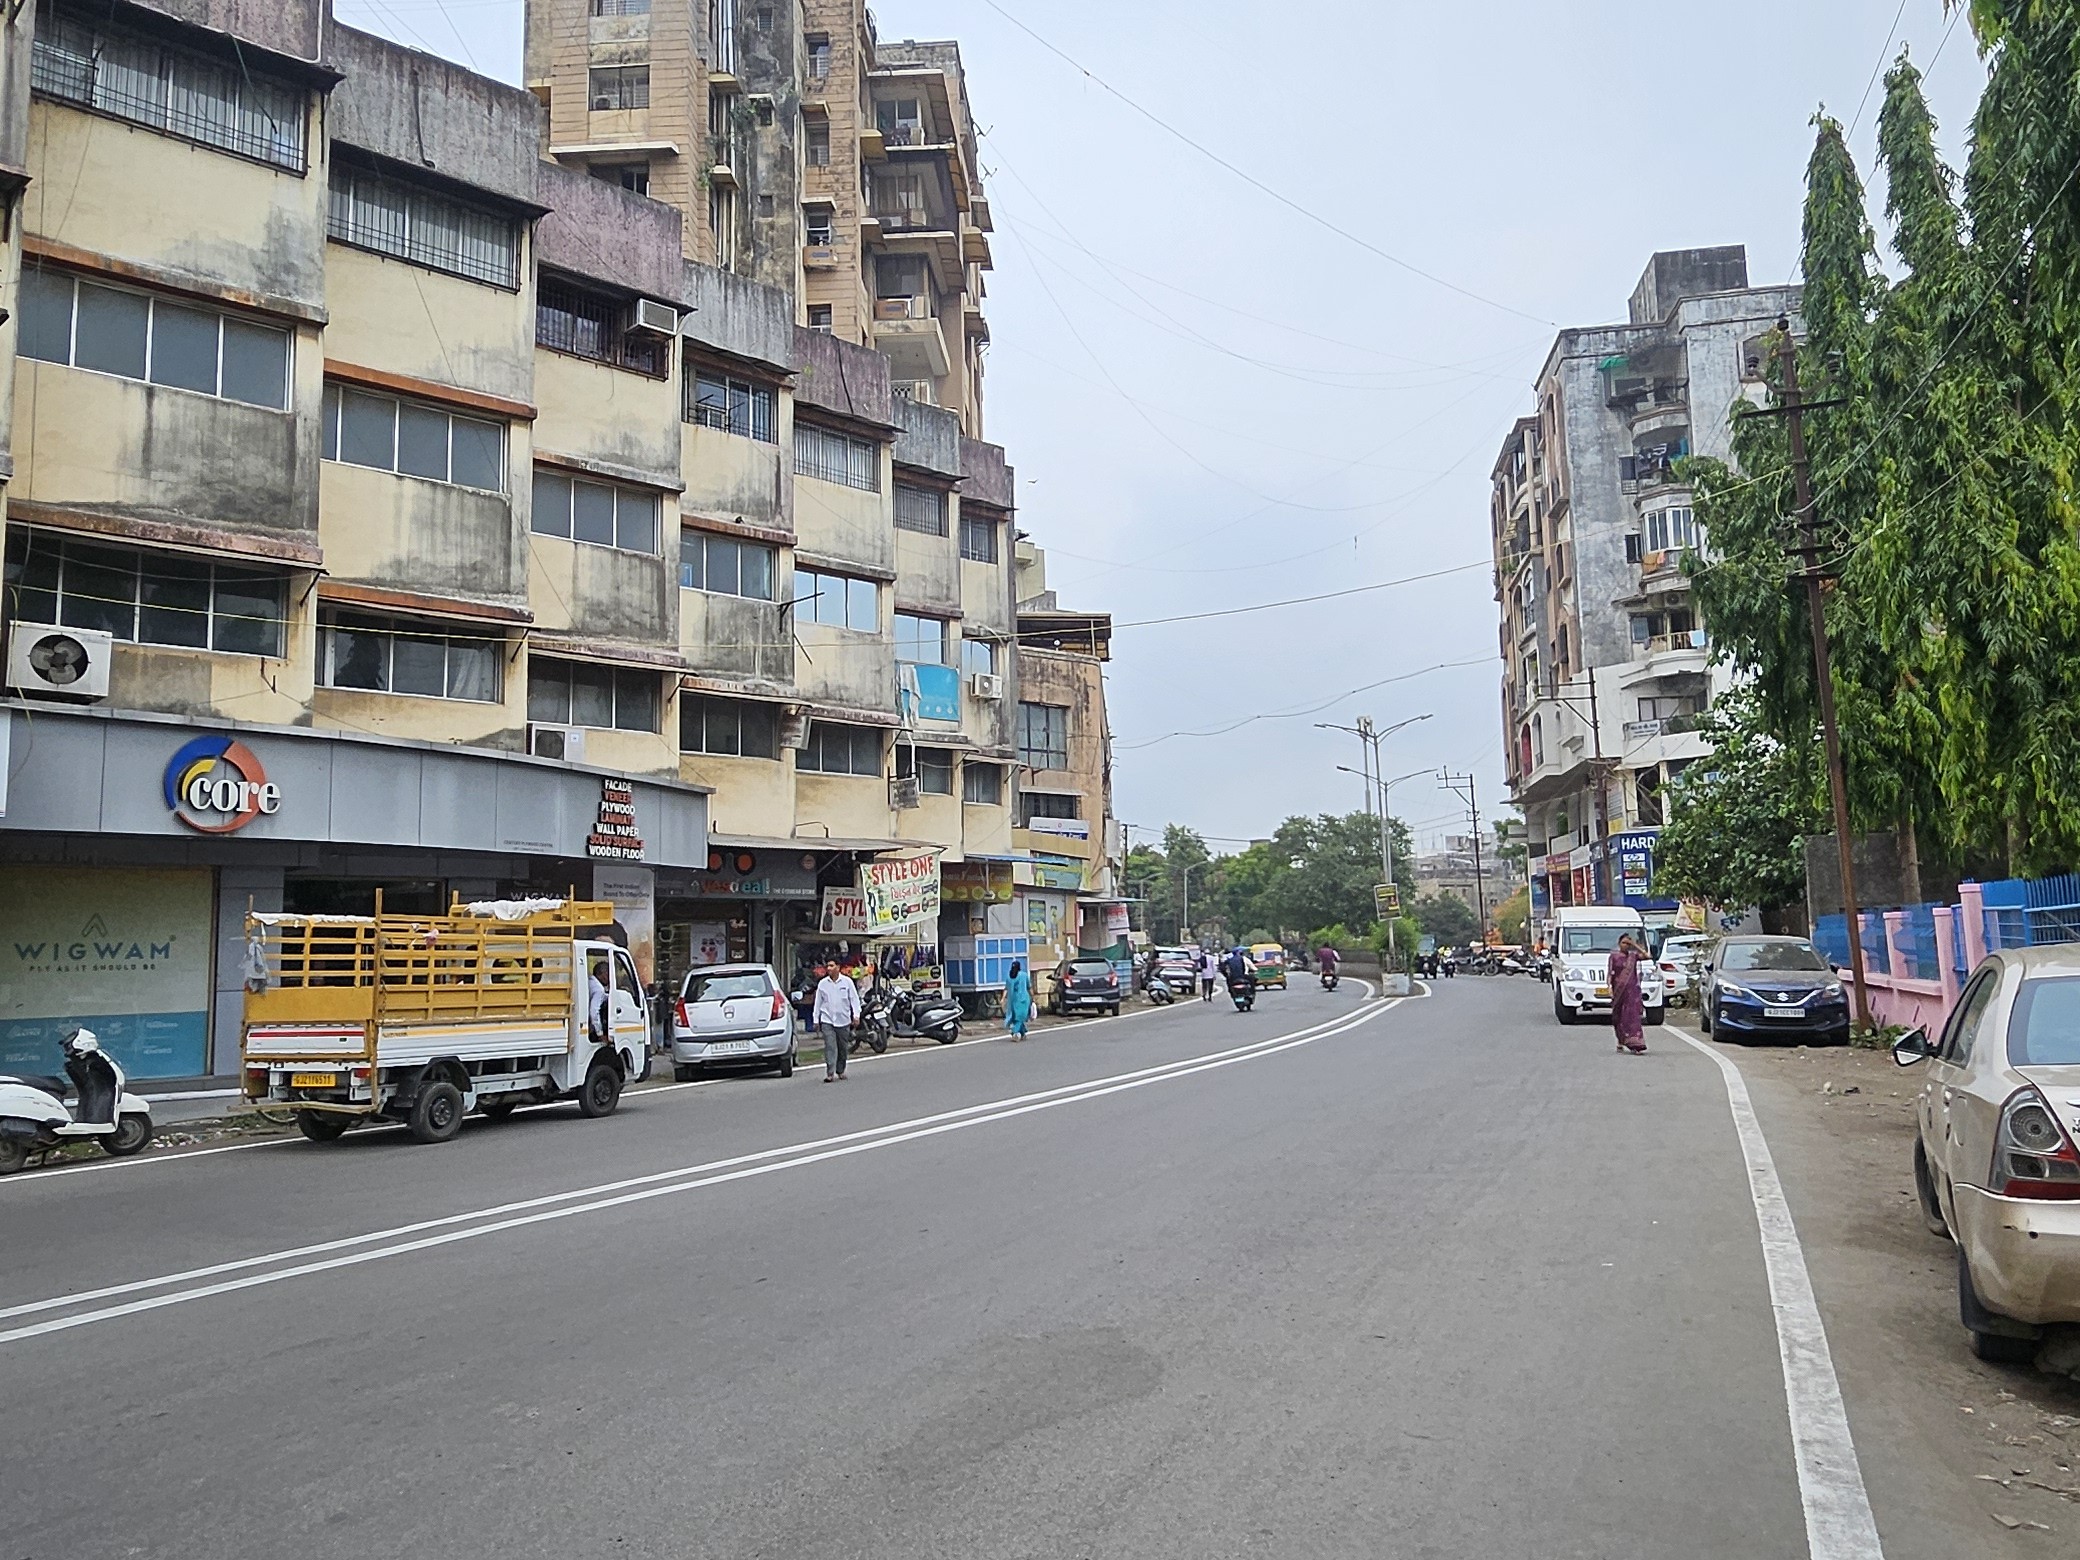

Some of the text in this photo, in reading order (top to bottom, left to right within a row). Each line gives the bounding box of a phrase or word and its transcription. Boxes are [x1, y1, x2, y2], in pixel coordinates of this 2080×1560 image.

[604, 780, 632, 792] FACADE
[189, 777, 281, 815] core
[601, 801, 636, 815] PLYWOOD
[596, 822, 639, 838] WALL PAPER
[589, 833, 612, 845] SOLID
[588, 844, 645, 860] WOODEN FLOOR
[871, 855, 934, 886] STYLE ONE
[833, 898, 868, 917] STYL
[14, 941, 170, 961] WIGWAM
